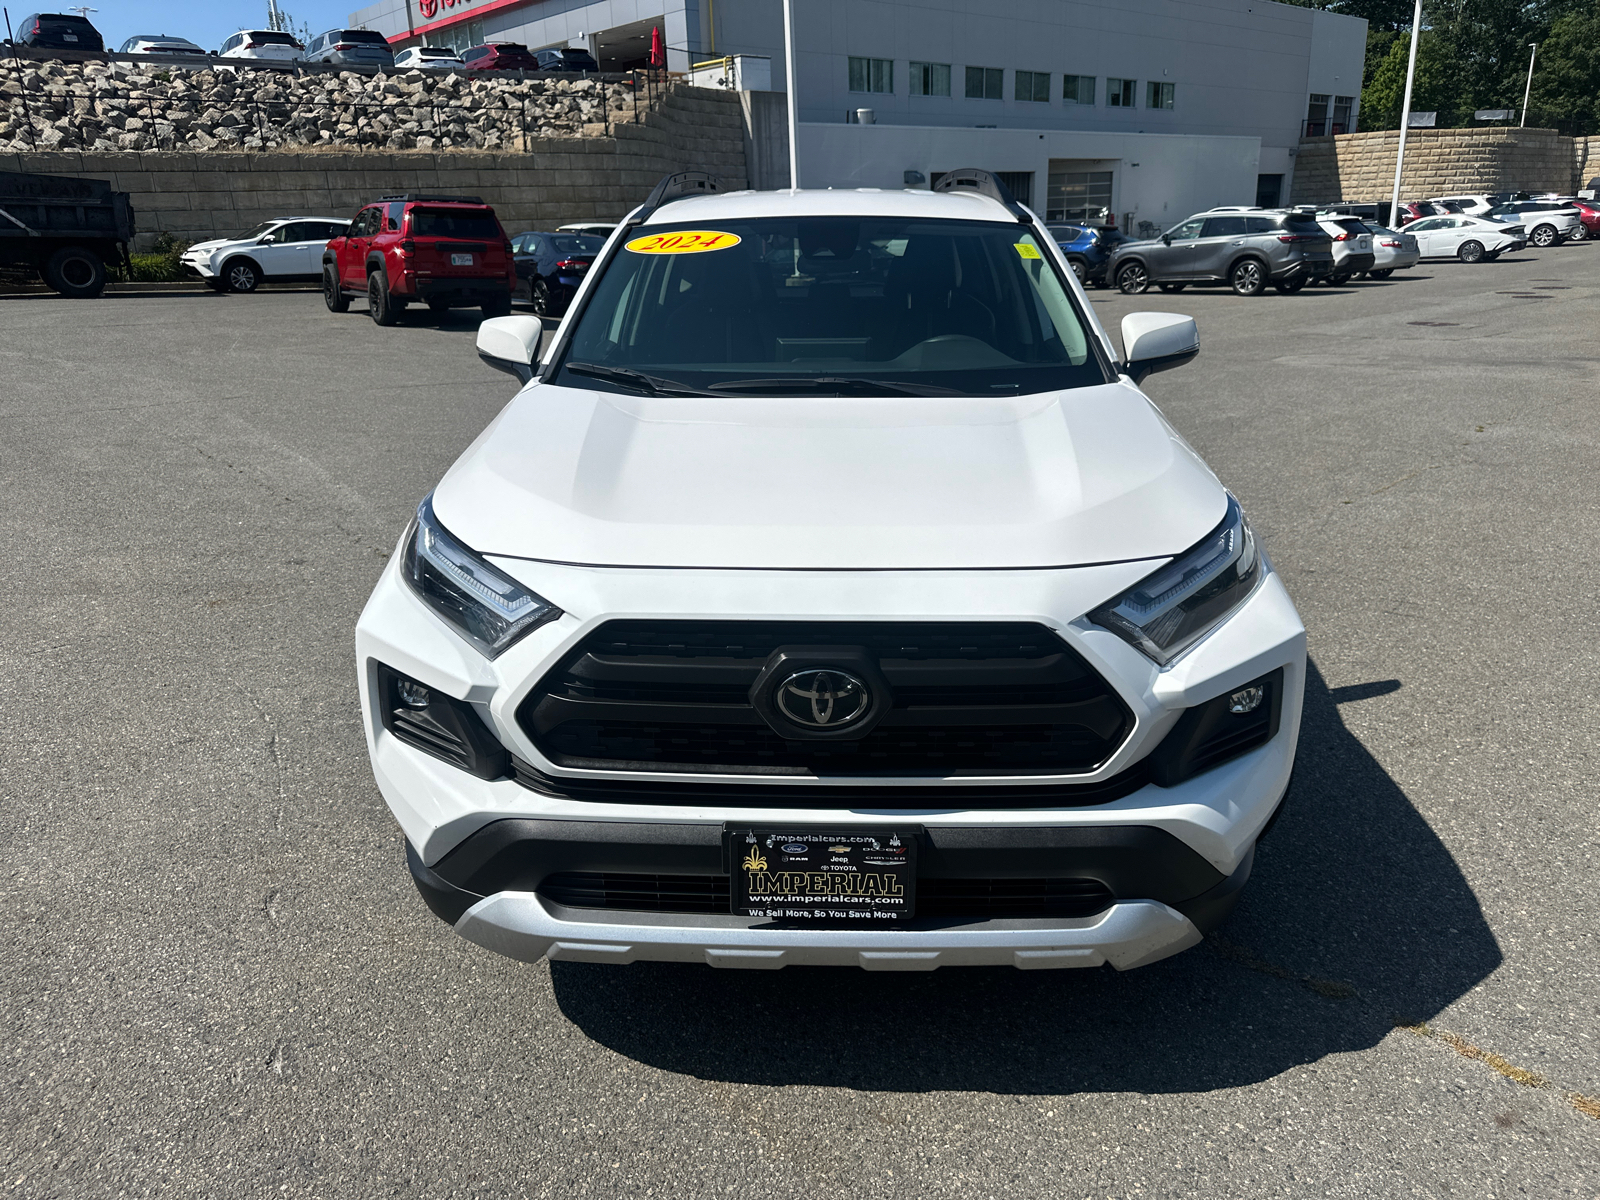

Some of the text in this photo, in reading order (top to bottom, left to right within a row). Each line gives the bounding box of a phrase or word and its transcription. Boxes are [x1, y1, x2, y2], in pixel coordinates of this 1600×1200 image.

[638, 234, 725, 251] 2024
[771, 834, 875, 843] Imperialcars.com
[830, 855, 849, 863] Jeep
[749, 871, 903, 896] IMPERIAL
[749, 894, 904, 904] www.imperialcars.com
[748, 909, 898, 919] We Sell More, So You Save More
